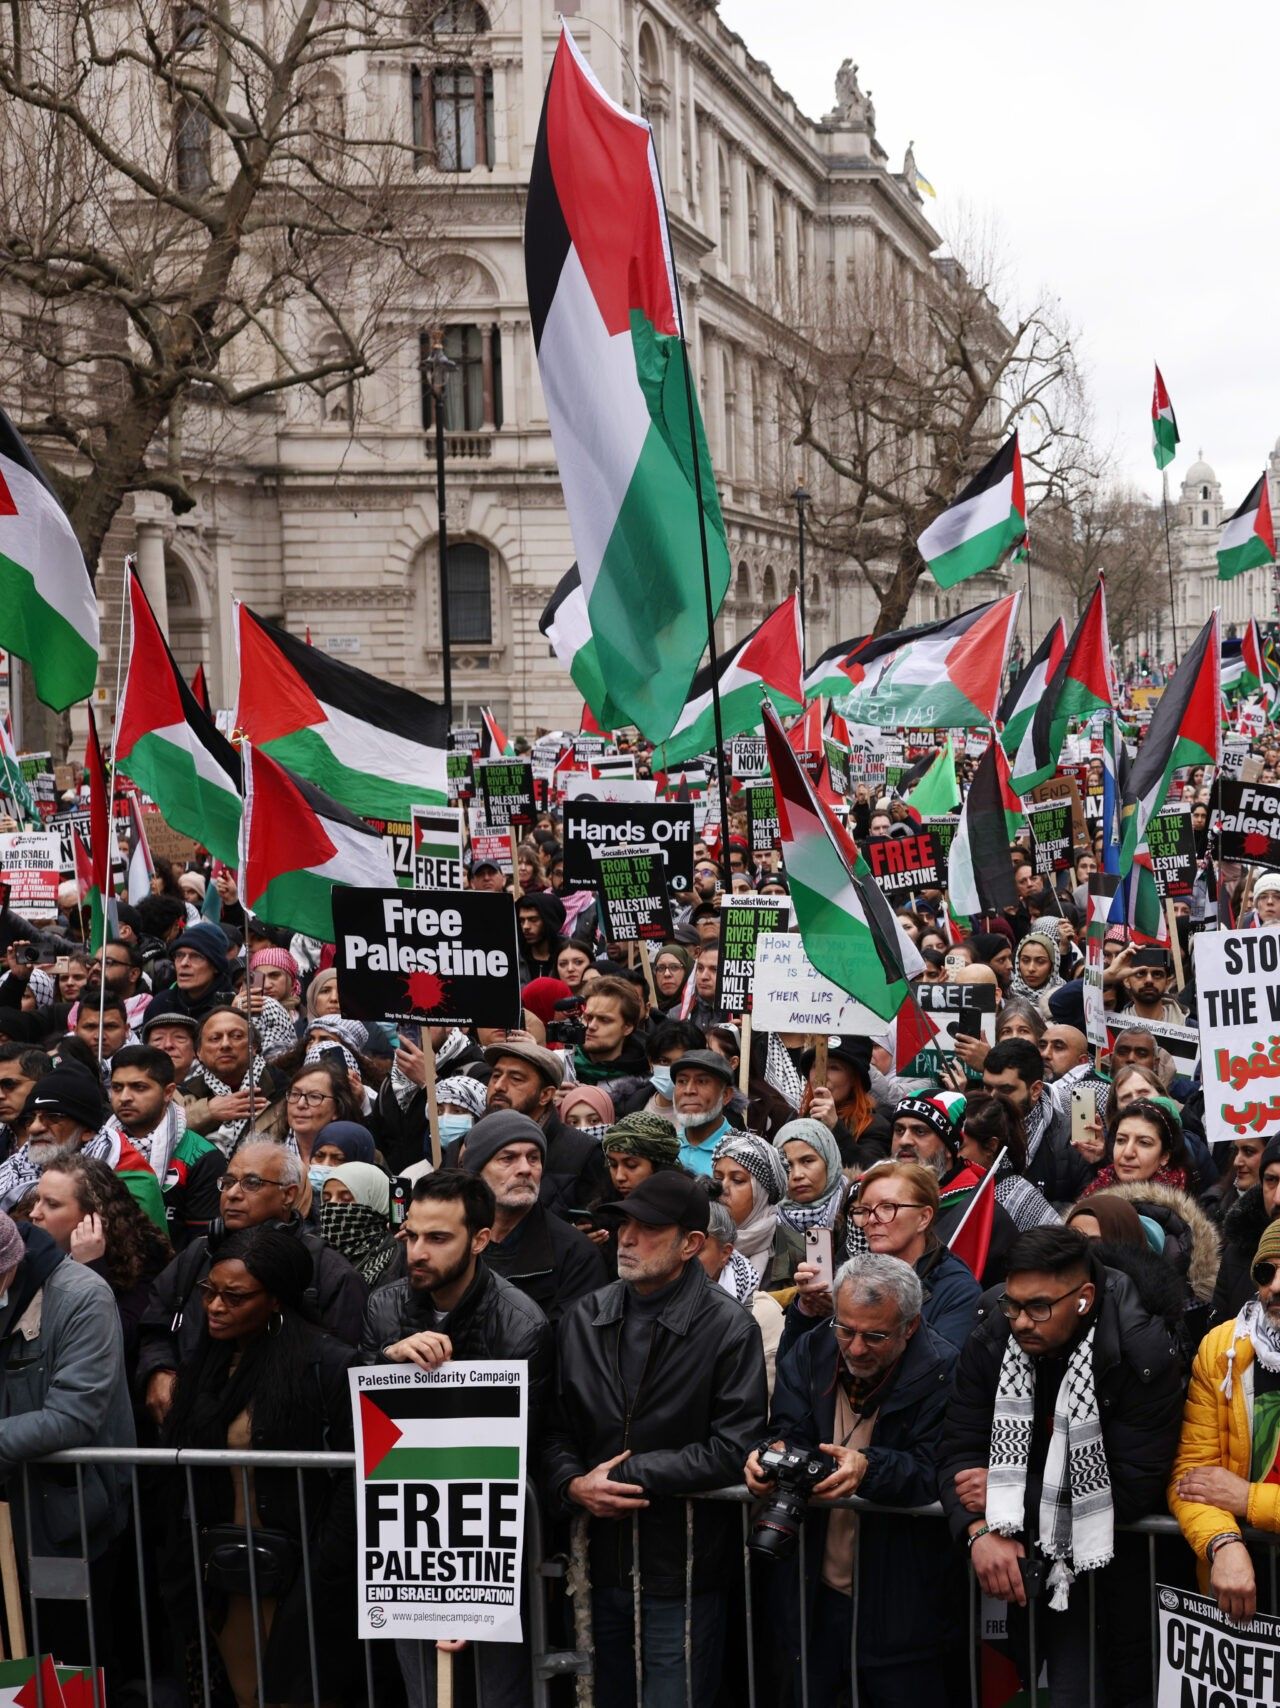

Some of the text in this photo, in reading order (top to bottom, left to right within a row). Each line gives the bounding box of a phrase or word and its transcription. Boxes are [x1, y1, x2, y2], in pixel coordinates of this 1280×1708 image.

[909, 732, 935, 746] GAZA
[734, 743, 767, 754] CEASEFI
[738, 755, 765, 770] NOW
[867, 753, 885, 763] STOP
[486, 764, 525, 776] FROM THE
[487, 775, 522, 786] RIVER TO
[488, 785, 520, 795] THE SEA
[751, 788, 773, 798] FROM
[1040, 785, 1070, 800] END
[489, 794, 531, 806] PALESTINE
[752, 799, 774, 809] RIVER
[490, 804, 521, 815] WILL BE
[752, 809, 767, 819] THE
[1033, 808, 1067, 822] FROM THE
[491, 815, 510, 825] FREE
[1034, 819, 1064, 833] RIVER TO
[1163, 815, 1183, 829] THE
[568, 818, 690, 842] Hands Off
[753, 829, 771, 840] WILL
[1049, 829, 1061, 840] SEA
[1166, 829, 1180, 842] TO
[753, 840, 772, 850] FREE
[1034, 837, 1070, 853] PALESTINE
[1158, 843, 1177, 856] SEA
[5, 849, 50, 860] END ISRAELI
[869, 834, 935, 876] FREE
[1035, 850, 1062, 863] WILL BE
[1, 859, 54, 870] STATE TERROR
[601, 856, 653, 873] FROM THE
[1036, 863, 1052, 874] FREE
[415, 856, 461, 889] FREE
[603, 870, 650, 886] RIVER TO
[875, 867, 938, 891] PALESTINE
[1166, 869, 1179, 883] BE
[605, 884, 648, 899] THE SEA
[608, 896, 662, 913] PALESTINE
[383, 898, 463, 937] Free
[609, 911, 652, 926] WILL BE
[727, 909, 779, 926] FROM THE
[612, 926, 638, 940] FREE
[725, 926, 754, 942] RIVER
[344, 935, 509, 977] Palestine
[725, 943, 743, 959] THE
[774, 954, 791, 964] AN
[722, 977, 745, 993] WILL
[720, 994, 744, 1010] FREE
[768, 991, 833, 1003] THEIR LIPS
[916, 984, 974, 1009] FREE
[1204, 987, 1258, 1027] THE
[789, 1012, 831, 1025] MOVING
[1169, 1028, 1200, 1041] Campaign
[897, 1100, 947, 1130] REE
[358, 1370, 520, 1387] Palestine Solidarity Campaign
[365, 1483, 519, 1549] FREE
[365, 1550, 516, 1583] PALESTINE
[368, 1587, 514, 1604] END ISRAELI OCCUPATION
[1183, 1597, 1224, 1624] PALESTINE
[392, 1612, 494, 1625] www.palestinecampaign.org
